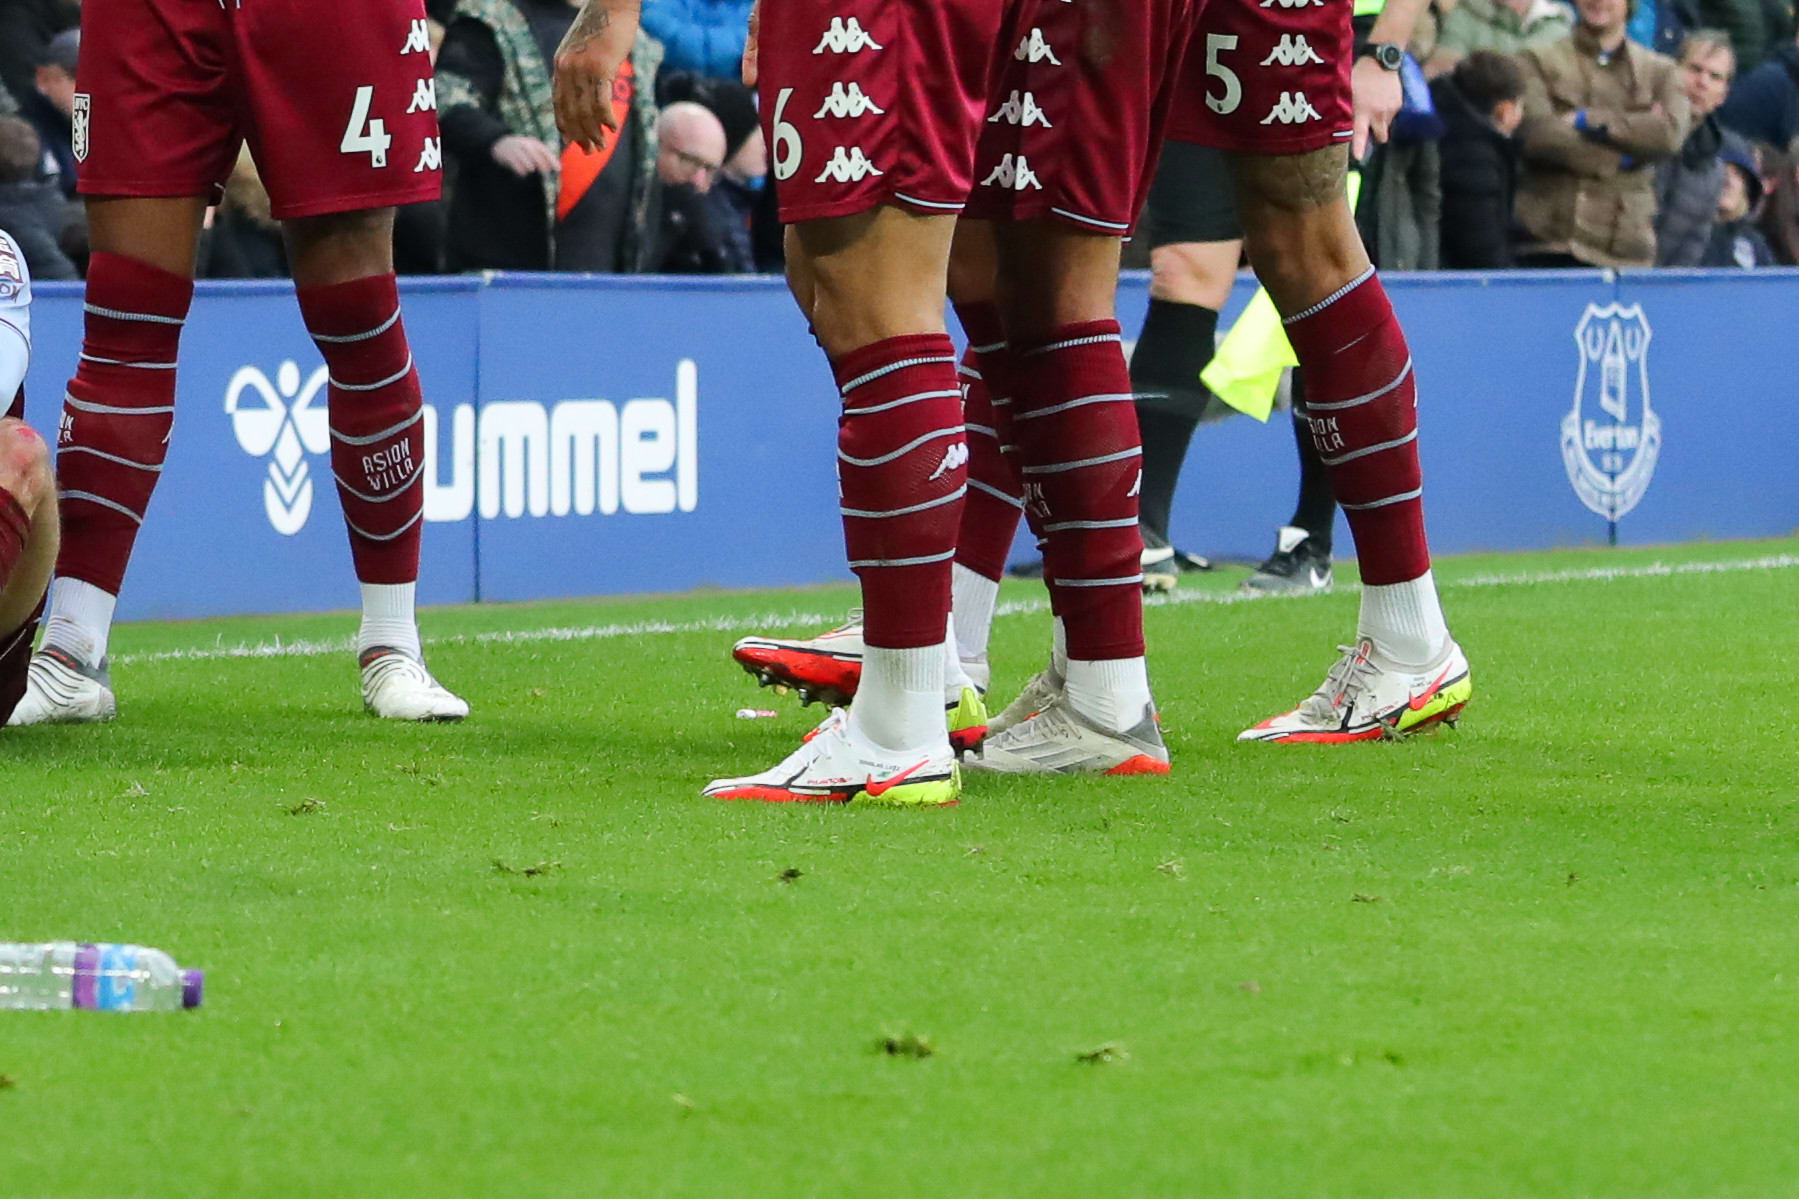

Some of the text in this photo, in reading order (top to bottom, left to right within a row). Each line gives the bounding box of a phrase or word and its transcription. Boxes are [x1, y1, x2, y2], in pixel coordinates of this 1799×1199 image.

[1205, 32, 1243, 115] 5
[340, 85, 393, 169] 4
[773, 87, 803, 181] 6
[423, 358, 698, 522] ummel
